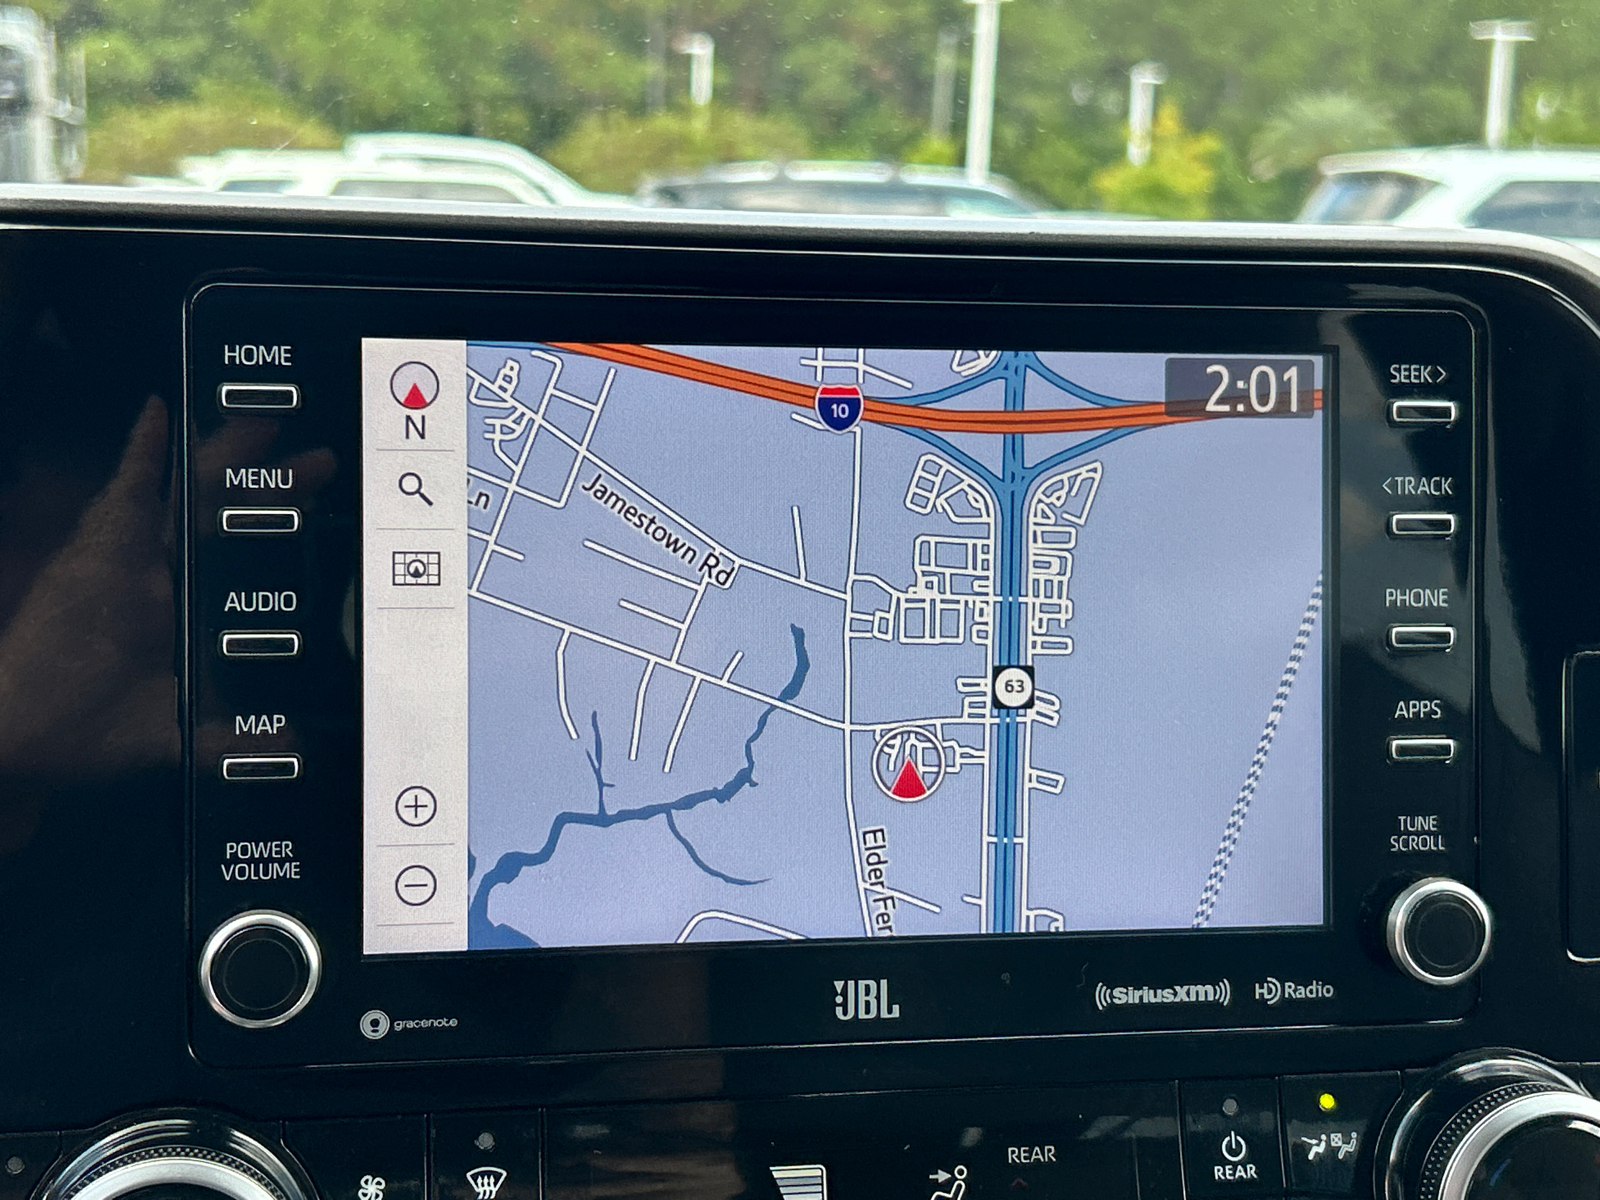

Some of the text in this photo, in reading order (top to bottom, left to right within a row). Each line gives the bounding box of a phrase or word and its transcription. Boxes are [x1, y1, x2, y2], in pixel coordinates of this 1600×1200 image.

[223, 344, 293, 366] HOME
[1205, 364, 1298, 413] 2:01
[830, 403, 850, 419] 10
[404, 414, 426, 440] N
[225, 468, 294, 489] MENU
[581, 473, 736, 587] Jamestown Rd
[224, 591, 298, 613] AUDIO
[1385, 588, 1449, 608] PHONE
[1004, 679, 1025, 694] 63
[1394, 700, 1442, 720] APPS
[235, 714, 287, 736] MAP
[1397, 815, 1438, 832] TUNE
[226, 841, 293, 859] POWER
[1390, 835, 1446, 853] SCROLL
[862, 827, 889, 889] Elder
[221, 862, 301, 881] VOLUME
[833, 978, 900, 1020] JBL
[1284, 980, 1335, 999] Radio
[393, 1017, 459, 1032] gracenote
[1007, 1145, 1057, 1164] REAR
[1213, 1164, 1258, 1181] REAR
